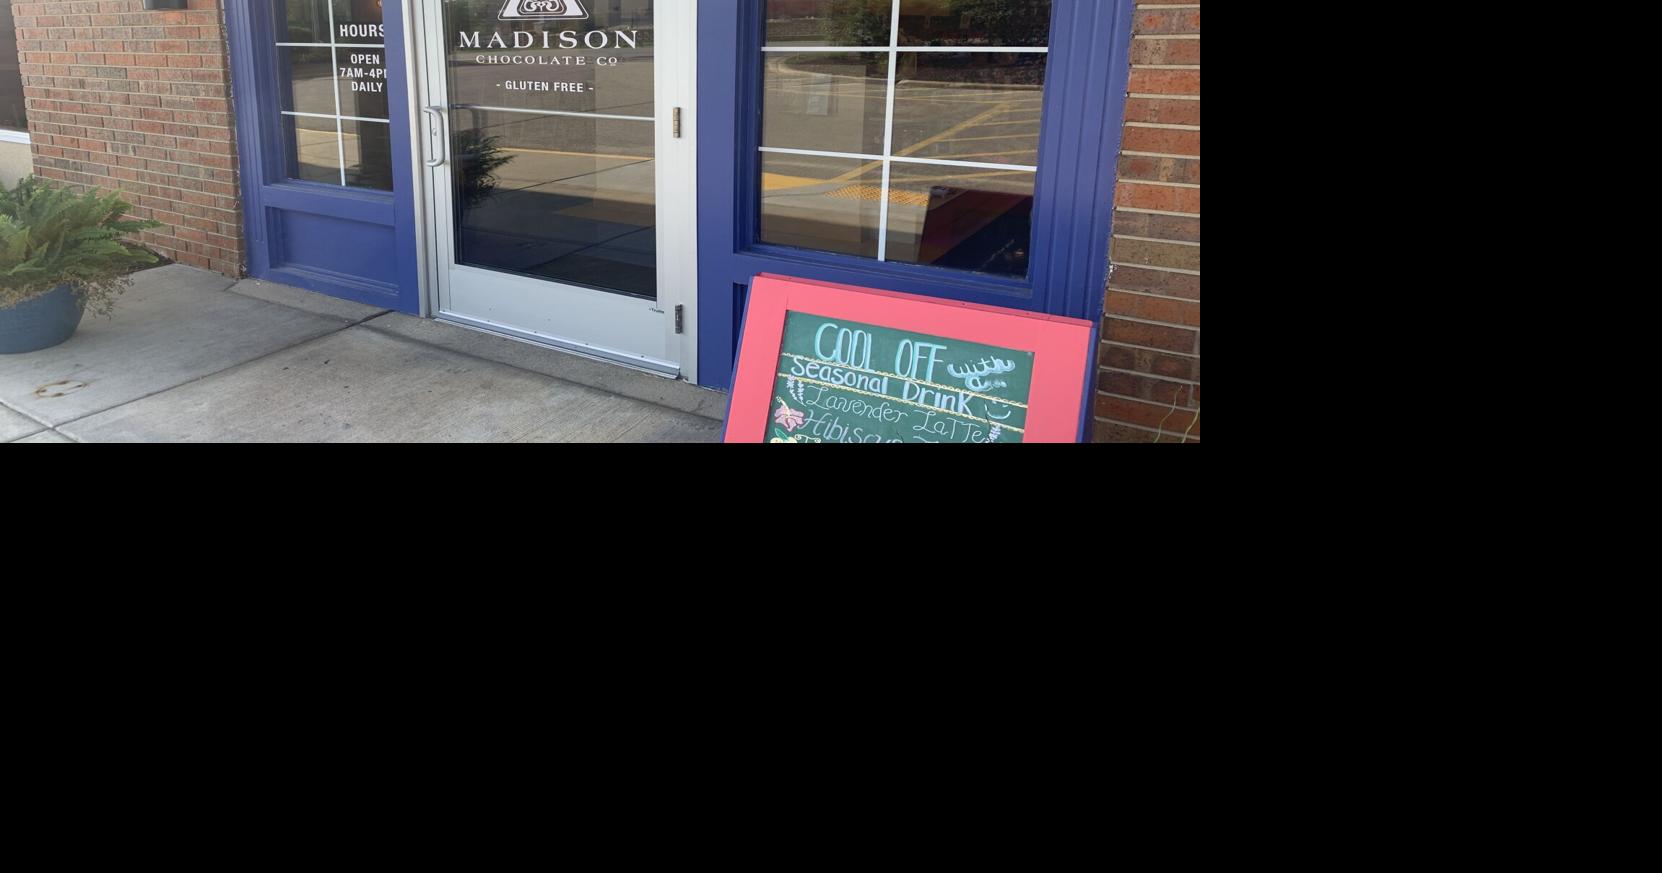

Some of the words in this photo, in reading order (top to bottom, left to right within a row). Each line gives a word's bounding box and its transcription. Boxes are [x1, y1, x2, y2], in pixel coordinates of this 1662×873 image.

[339, 24, 385, 38] HOURS
[459, 30, 638, 49] MADISON
[350, 53, 380, 65] OPEN
[475, 54, 586, 66] CHOCOLATE
[351, 81, 383, 93] DAILY
[505, 80, 549, 92] GLUTEN
[553, 81, 584, 93] FREE
[814, 322, 876, 373] COOL
[894, 338, 948, 382] OFF
[946, 355, 1016, 379] with
[790, 356, 889, 395] Seasonal
[806, 385, 909, 423] Lavender
